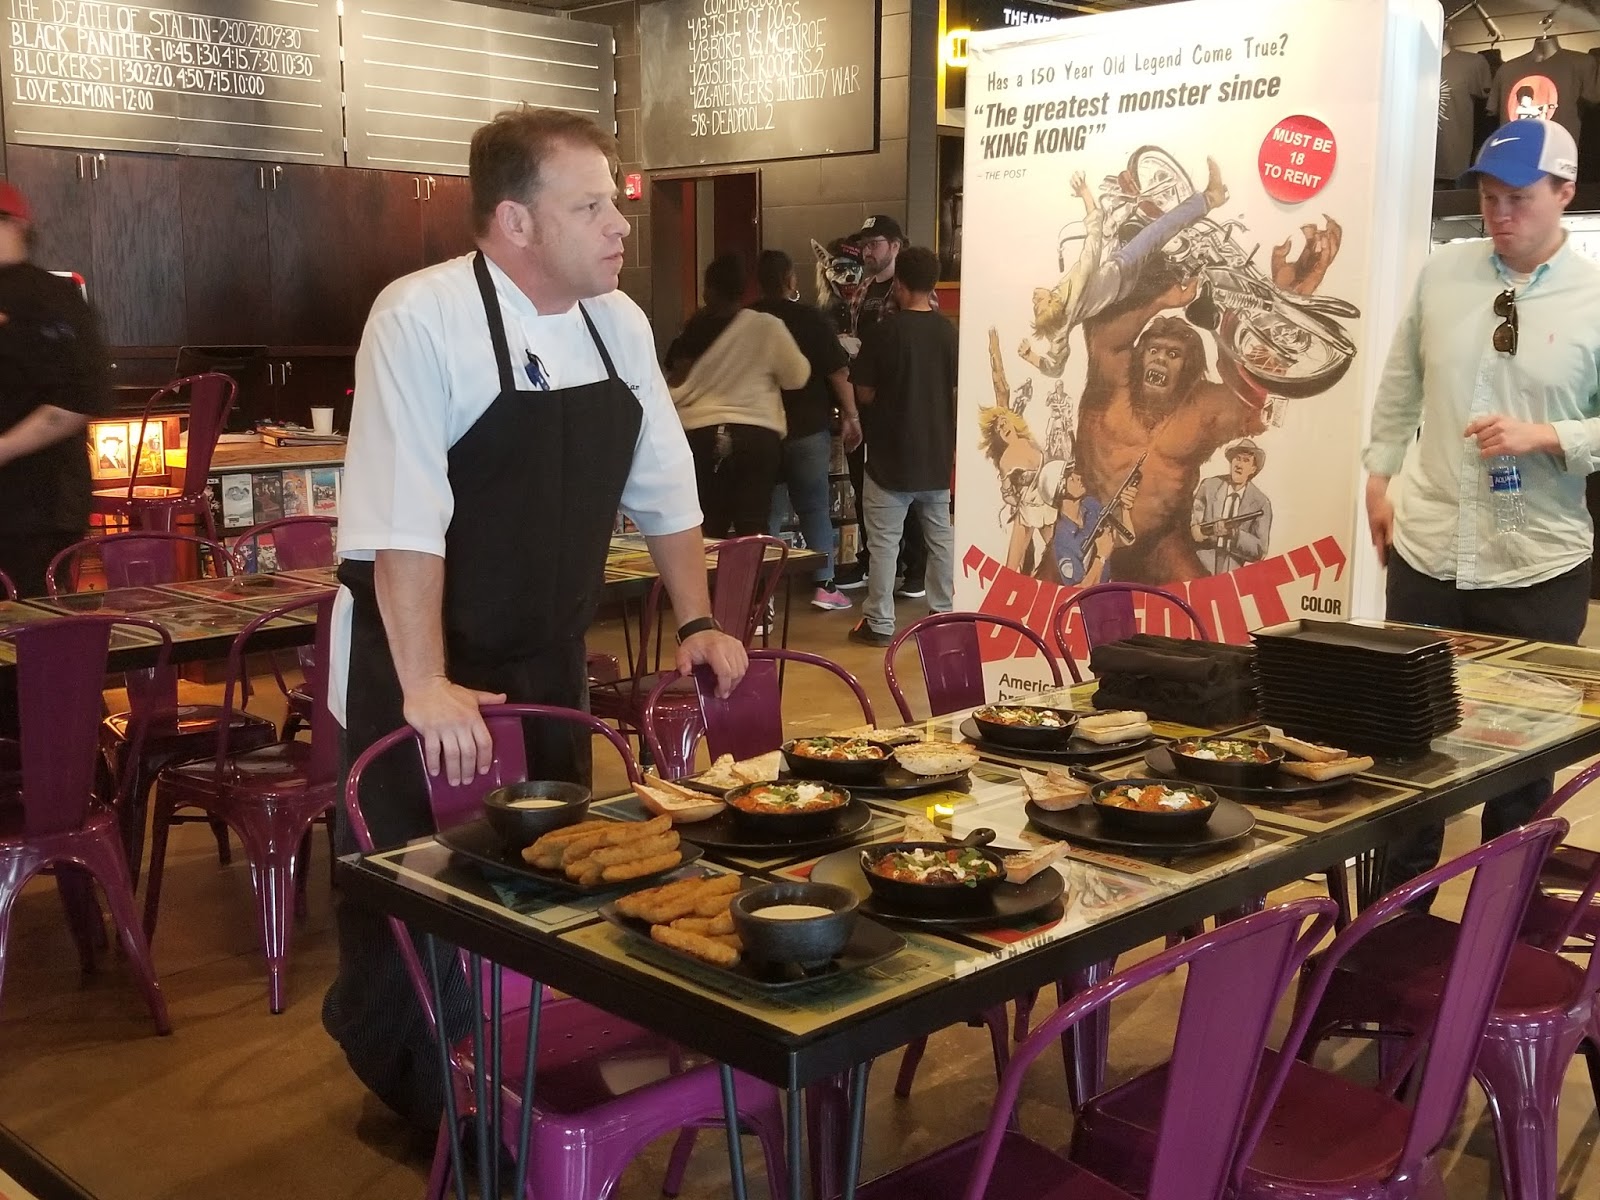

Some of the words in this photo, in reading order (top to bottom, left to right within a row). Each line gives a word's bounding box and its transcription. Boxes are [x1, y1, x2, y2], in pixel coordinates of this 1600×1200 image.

[52, 0, 110, 29] DEATH
[116, 7, 140, 33] OF
[746, 6, 764, 33] OF
[767, 1, 802, 30] DOGS
[1003, 8, 1058, 26] THEAT
[11, 21, 69, 52] BLACK
[746, 31, 762, 55] VS
[750, 50, 812, 80] TROOPERS
[813, 47, 824, 73] 2
[987, 71, 1009, 91] Has
[1016, 74, 1023, 88] a
[1031, 66, 1056, 86] 150
[1064, 61, 1094, 80] Year
[1103, 55, 1126, 75] Old
[1135, 47, 1182, 75] Legend
[1192, 44, 1233, 65] Come
[1244, 33, 1289, 59] True?
[777, 69, 829, 102] INFINITY
[831, 65, 861, 97] WAR
[1023, 92, 1110, 129] greatest
[1118, 82, 1212, 114] monster
[1218, 74, 1282, 102] since
[711, 106, 765, 136] DEADPOOL
[765, 103, 775, 130] 2
[1272, 127, 1313, 148] MUST
[1312, 137, 1334, 153] BE
[1290, 151, 1305, 165] 18
[985, 171, 1001, 180] THE
[1003, 169, 1028, 179] POST
[1264, 163, 1282, 179] TO
[1283, 168, 1322, 189] RENT
[1300, 595, 1342, 616] COLOR
